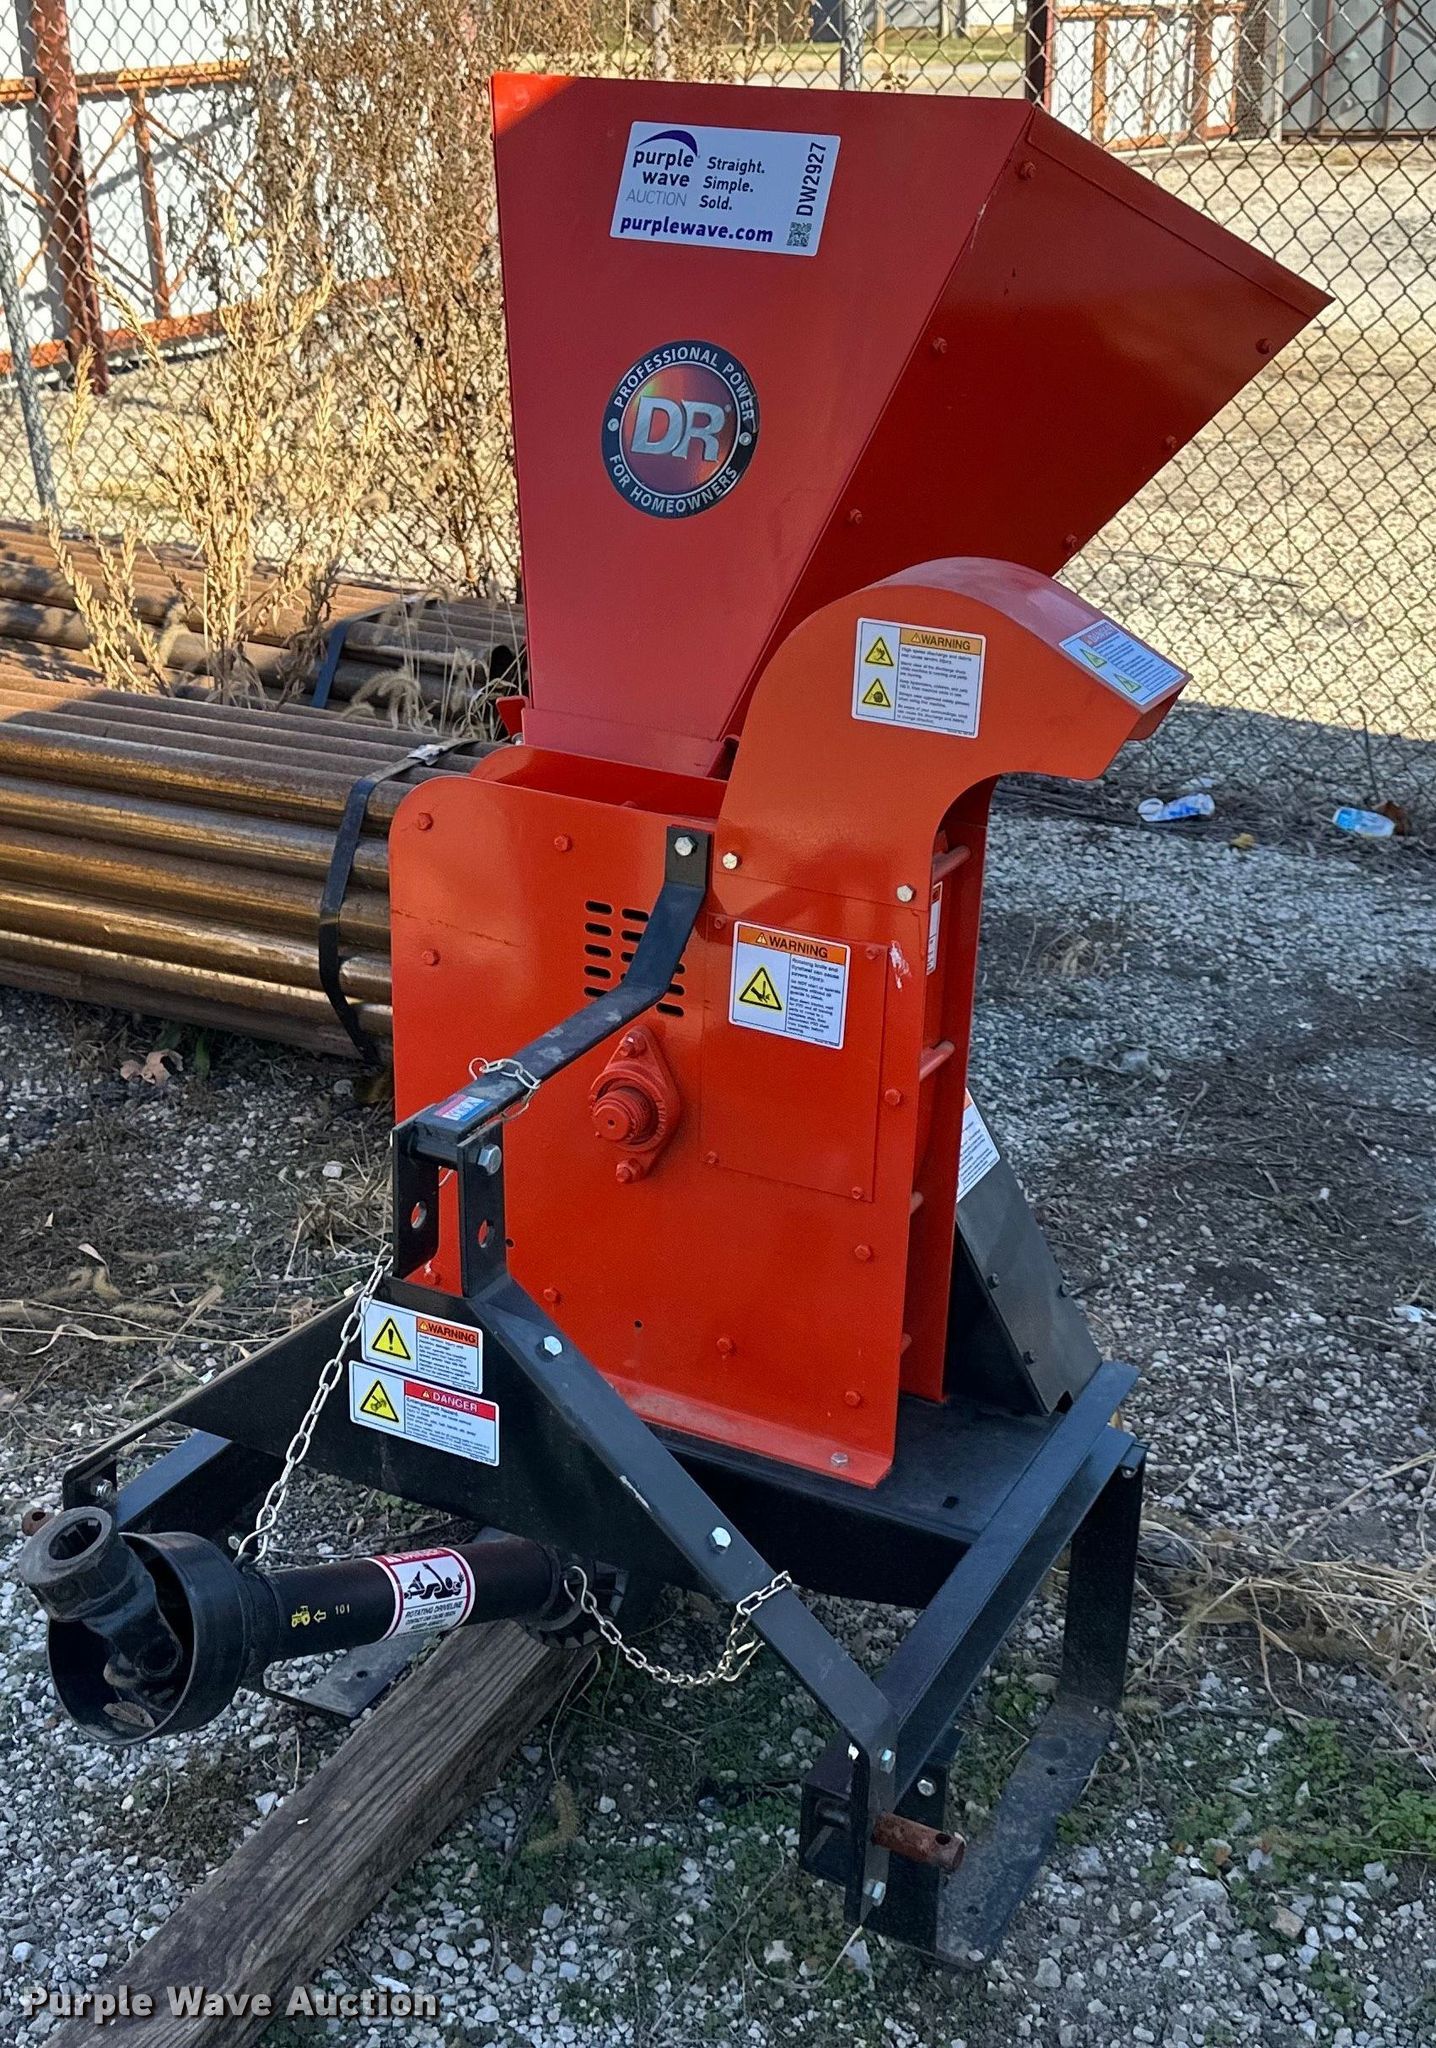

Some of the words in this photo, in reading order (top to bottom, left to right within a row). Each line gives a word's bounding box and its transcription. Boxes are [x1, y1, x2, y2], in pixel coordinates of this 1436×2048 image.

[633, 149, 694, 170] purple
[707, 156, 765, 174] Straight.
[642, 171, 690, 187] wave
[702, 176, 754, 193] Simple.
[796, 142, 826, 216] DW2927
[626, 188, 687, 207] AUCTION
[699, 195, 733, 210] Sold.
[620, 216, 773, 243] purplewave.com
[614, 346, 718, 408] PROFESSIONAL
[722, 362, 755, 422] POWER
[631, 396, 725, 463] DR
[610, 454, 630, 488] FOR
[630, 466, 737, 513] HOMEOWNERS
[920, 634, 971, 650] WARNING
[769, 935, 828, 958] WARNING
[428, 1322, 476, 1344] WARNING
[432, 1392, 478, 1412] DANGER
